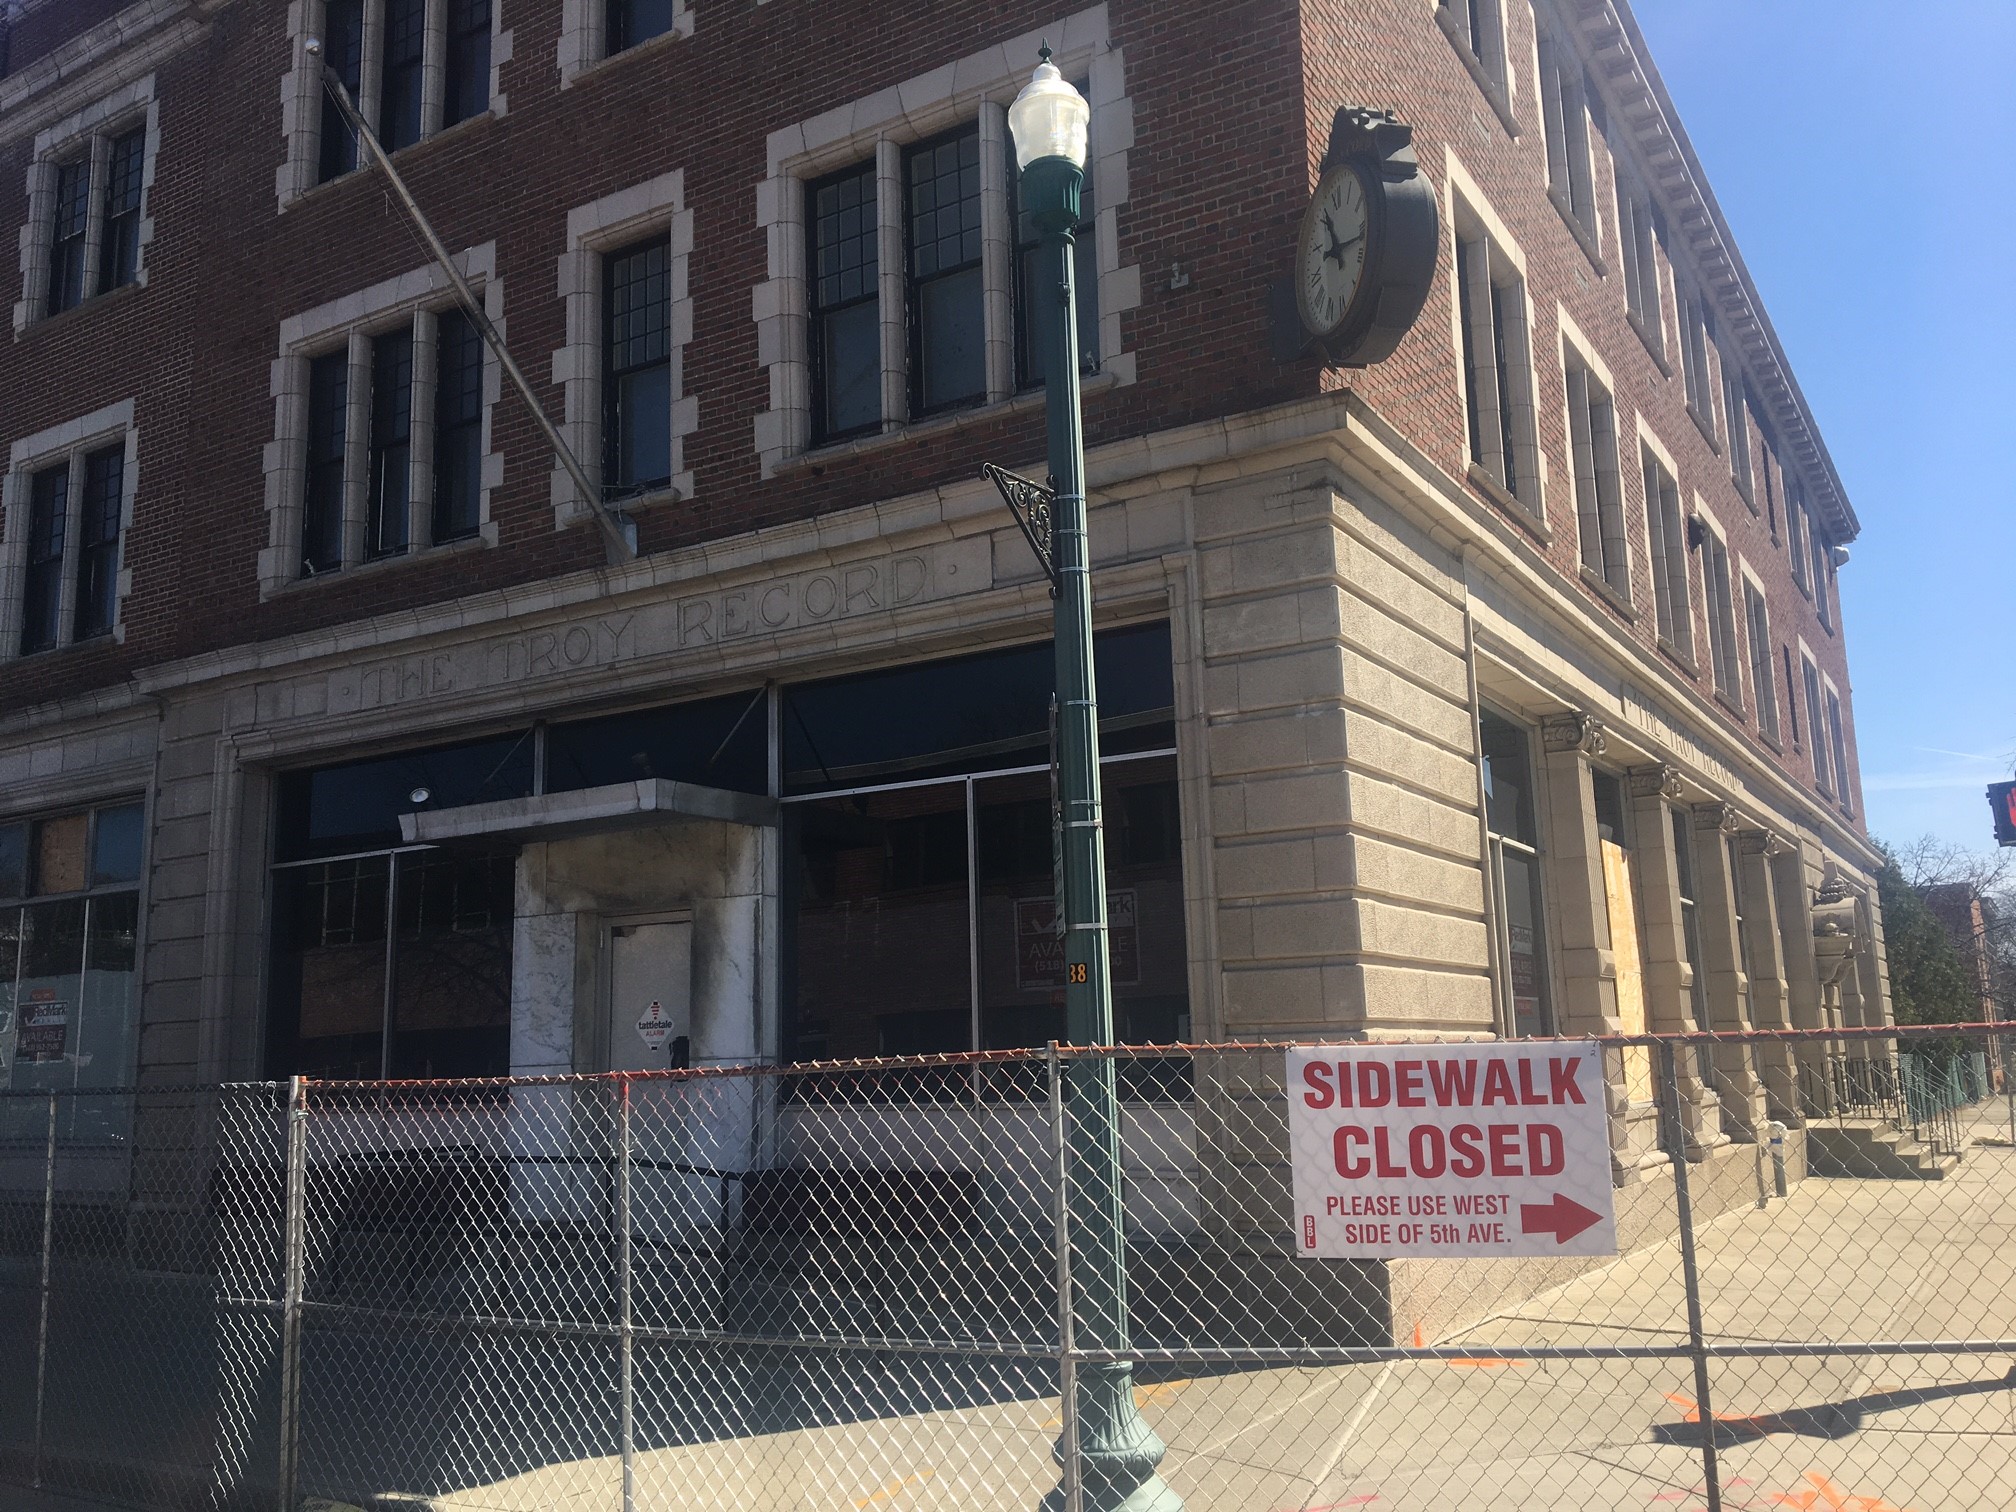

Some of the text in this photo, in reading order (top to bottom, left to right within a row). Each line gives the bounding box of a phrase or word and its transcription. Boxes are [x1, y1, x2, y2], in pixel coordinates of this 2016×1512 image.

[363, 556, 927, 703] THE TROY RECORD
[638, 1020, 672, 1030] tattletale
[1303, 1057, 1586, 1109] SIDEWALK
[1333, 1124, 1566, 1179] CLOSED
[1327, 1195, 1510, 1216] PLEASE USE WEST
[1305, 1217, 1315, 1247] BBL
[1345, 1223, 1512, 1244] SIDE OF 5th AVE.
